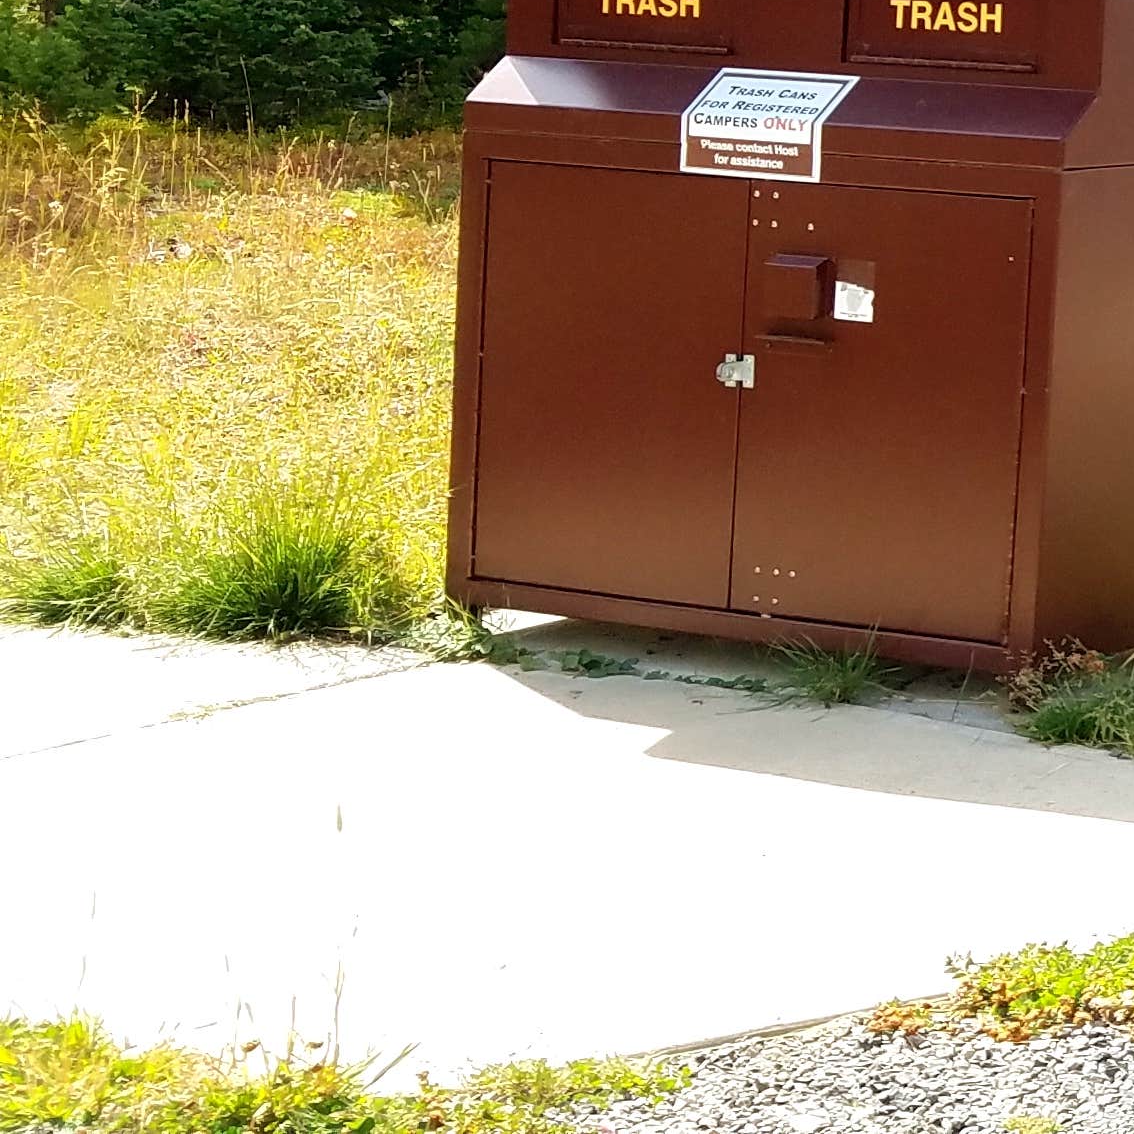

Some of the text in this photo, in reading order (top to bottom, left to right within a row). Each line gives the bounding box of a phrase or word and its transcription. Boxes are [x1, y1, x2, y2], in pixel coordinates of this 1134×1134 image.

[890, 0, 1002, 33] TRASH
[728, 85, 818, 101] TRASH CANS
[701, 99, 819, 115] FOR REGISTERED
[694, 112, 809, 132] CAMPERS ONLY
[701, 139, 799, 157] Please contact Host
[714, 153, 784, 170] for assistance
